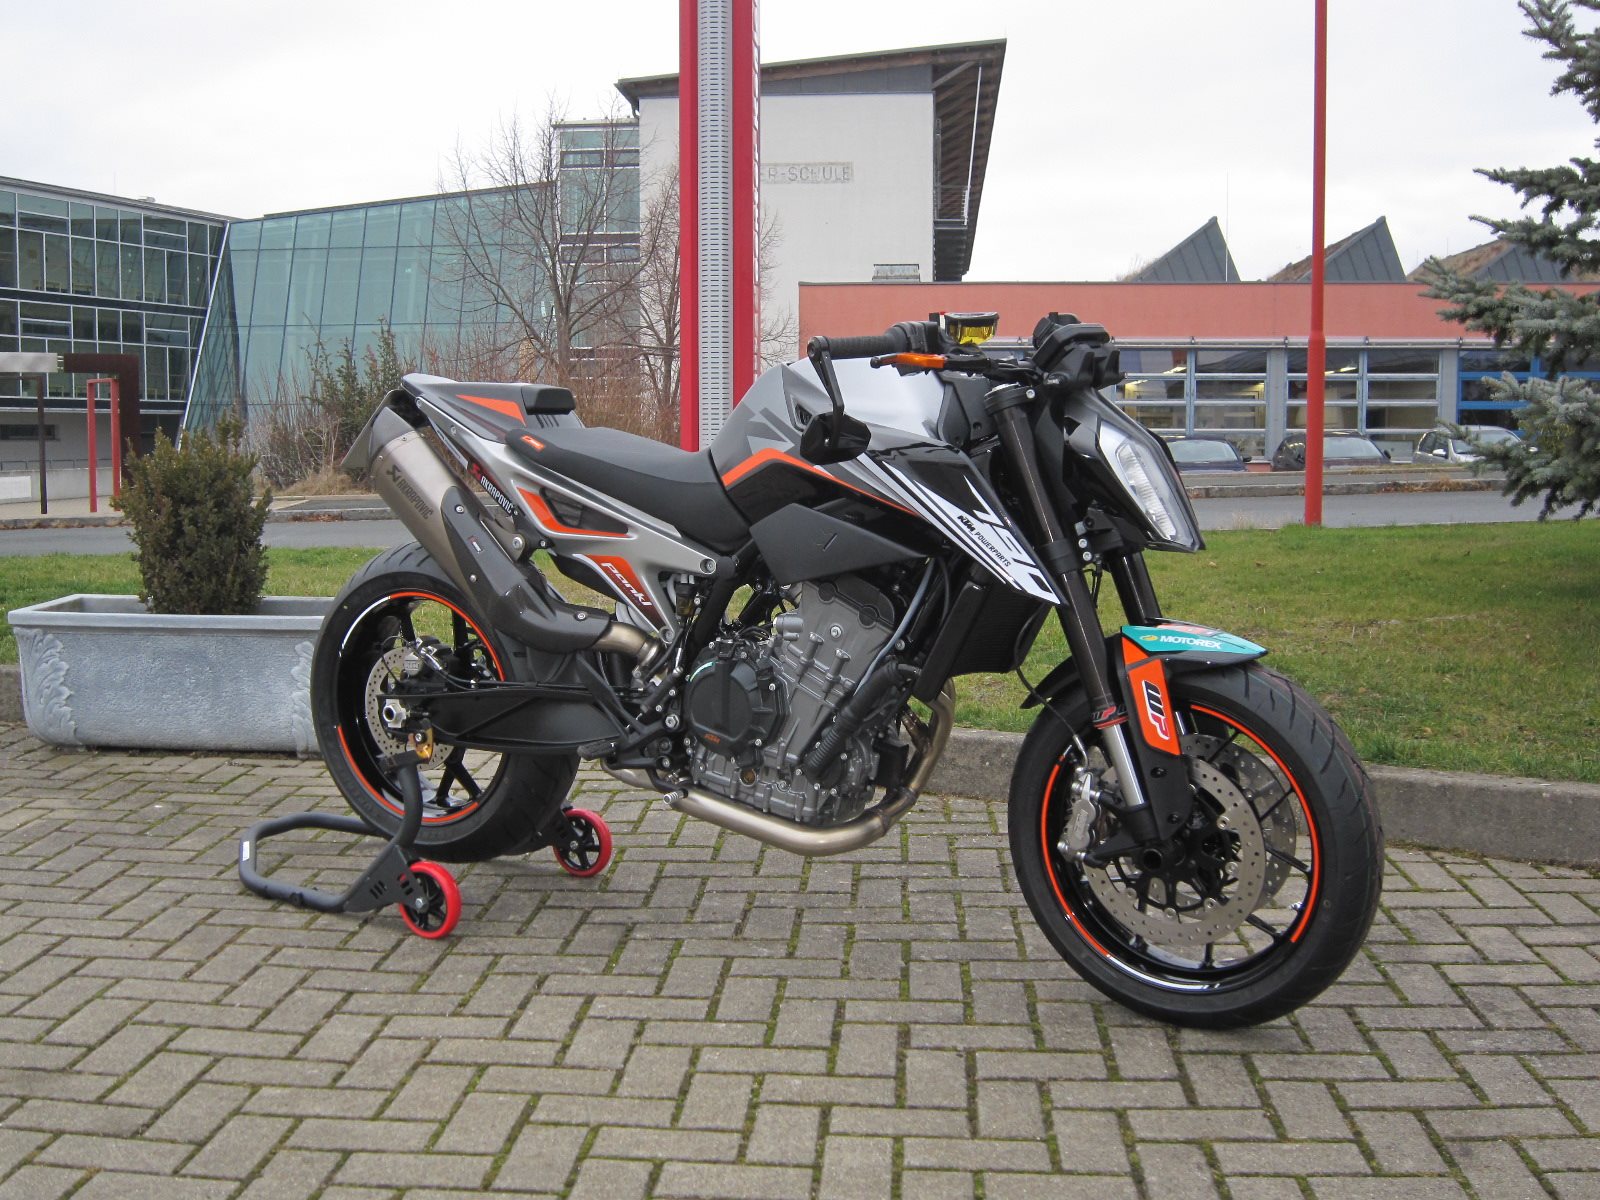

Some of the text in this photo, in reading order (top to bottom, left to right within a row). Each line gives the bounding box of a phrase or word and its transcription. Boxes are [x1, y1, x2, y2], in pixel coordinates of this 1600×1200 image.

[957, 514, 1012, 568] KTM POWERPARTS
[1160, 635, 1223, 650] MOTOREX
